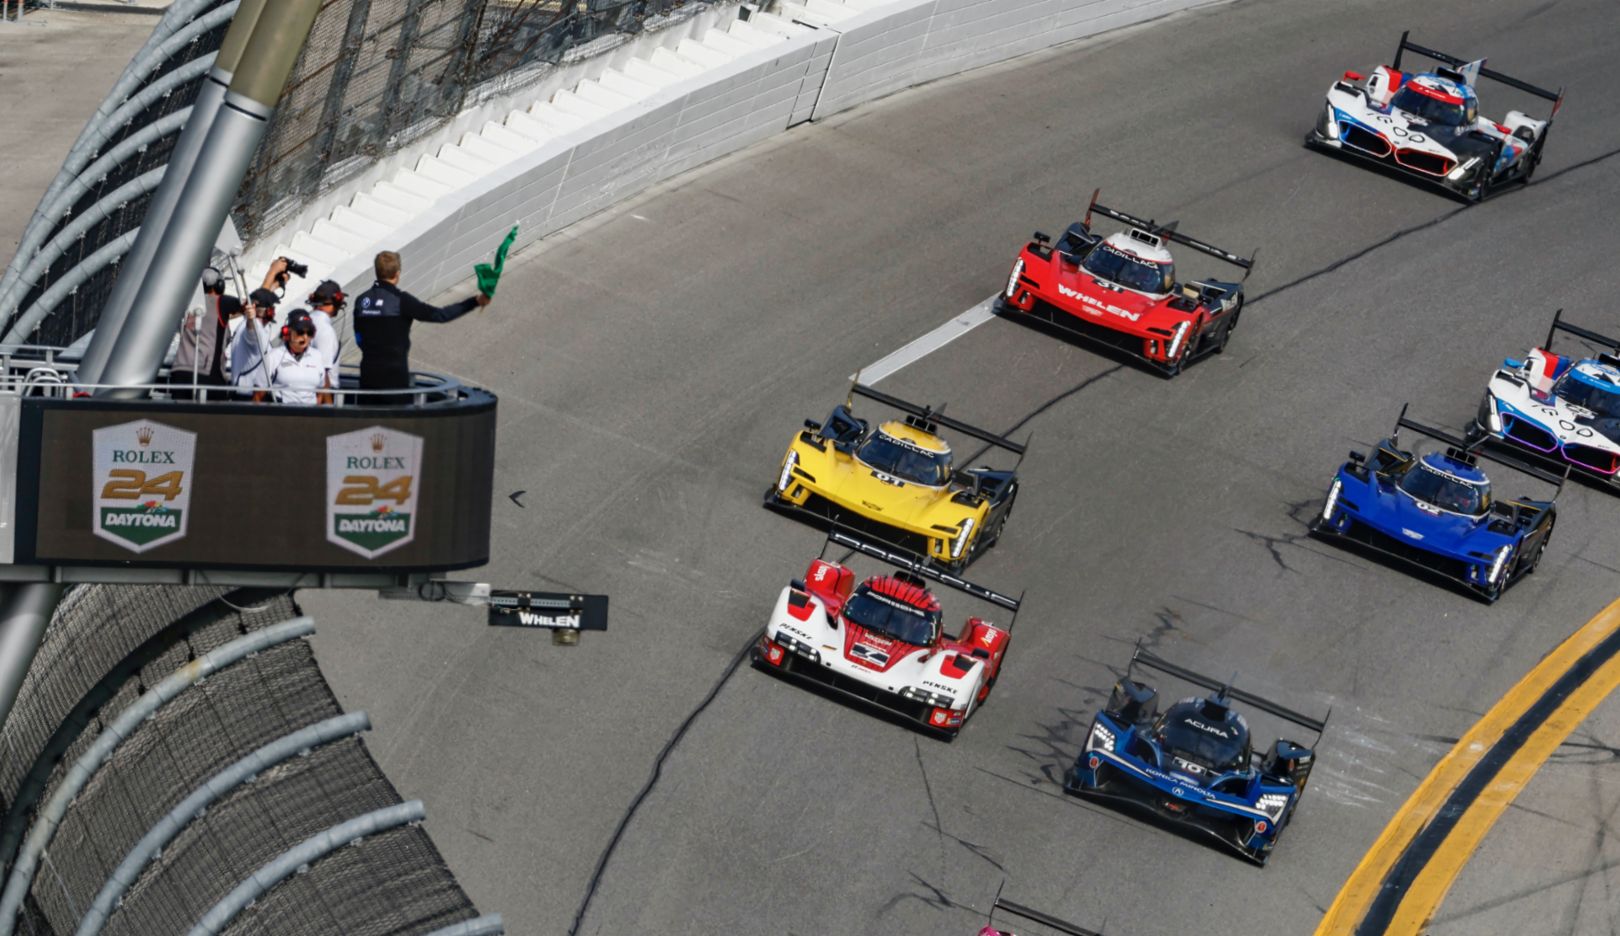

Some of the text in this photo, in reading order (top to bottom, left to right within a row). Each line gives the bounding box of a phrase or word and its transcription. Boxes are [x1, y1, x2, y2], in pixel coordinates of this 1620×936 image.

[1058, 283, 1141, 321] WHELEN
[879, 434, 934, 458] CADILLAC
[112, 450, 176, 464] ROLEX
[346, 456, 406, 470] ROLEX
[101, 469, 184, 501] 24
[335, 475, 413, 506] 24
[105, 512, 176, 528] DAYTONA
[339, 518, 406, 533] DAYTONA
[520, 611, 580, 628] WHELEN
[922, 680, 958, 695] PENSKE
[1184, 718, 1229, 739] ACURA
[1145, 768, 1216, 800] KONICA MINOLTA
